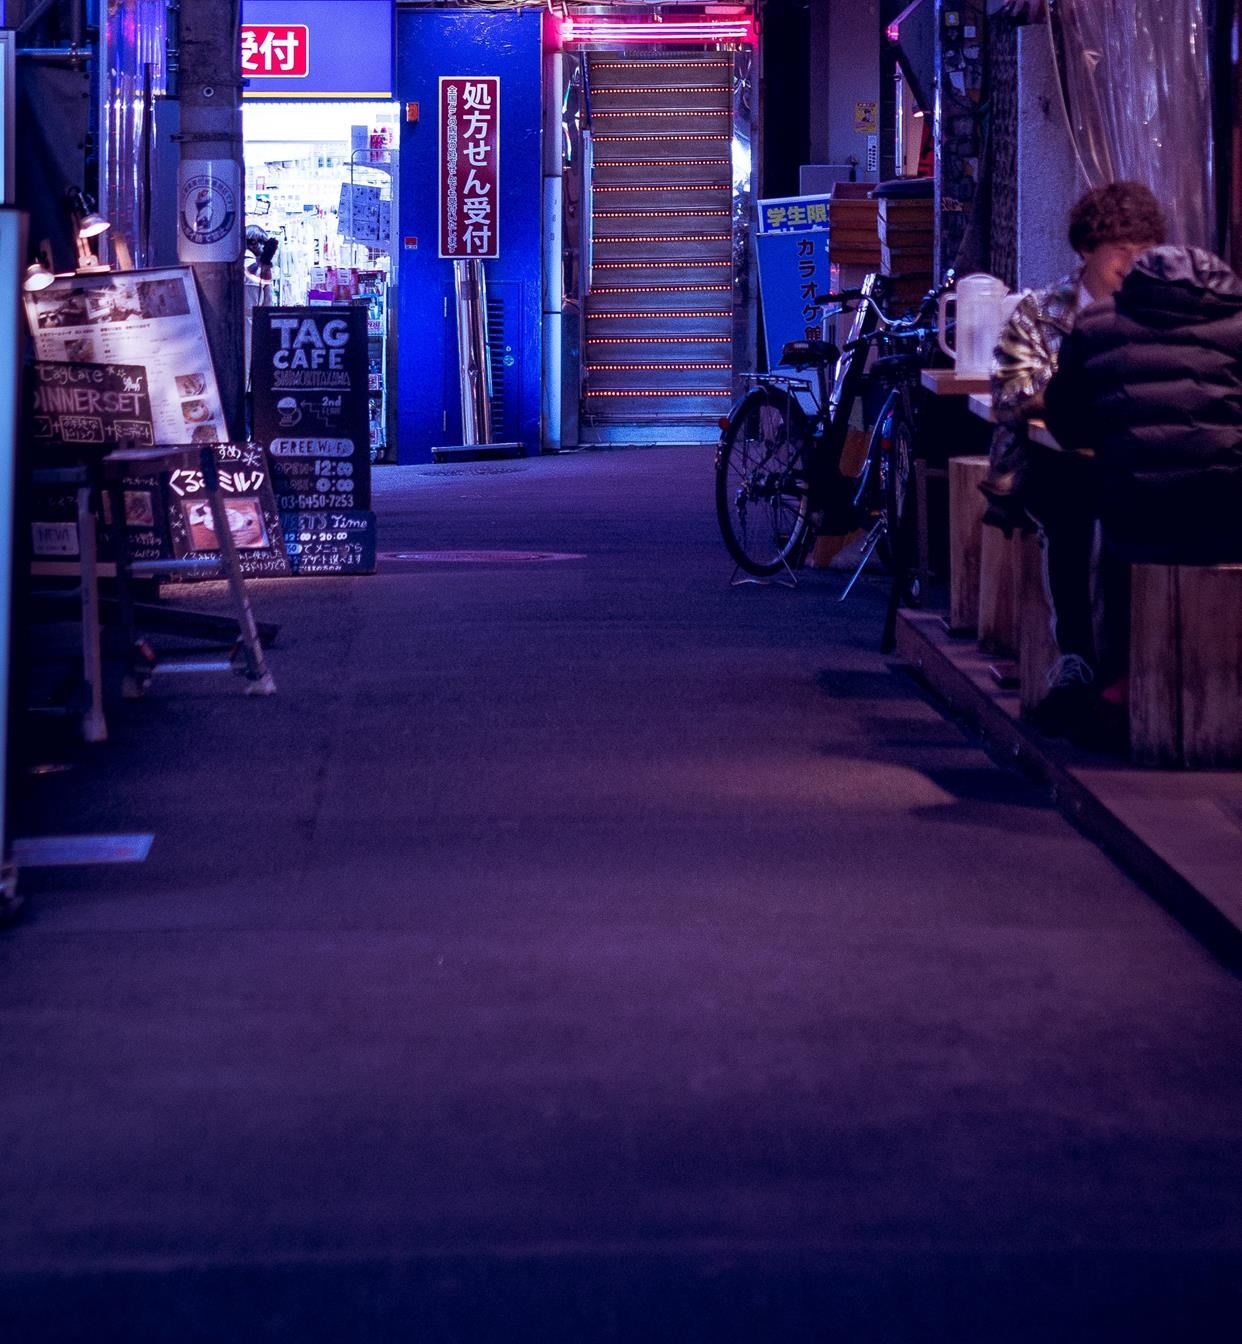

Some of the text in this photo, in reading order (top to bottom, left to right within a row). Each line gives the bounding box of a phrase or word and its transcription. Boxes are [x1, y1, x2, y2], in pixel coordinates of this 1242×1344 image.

[462, 82, 492, 254] 処方せん受付
[766, 204, 832, 230] 学生限
[270, 318, 350, 349] TAG
[272, 348, 346, 370] CAFE
[321, 395, 342, 407] 2nd
[280, 441, 314, 453] FREE
[314, 459, 354, 476] 12:00
[331, 514, 368, 529] Time
